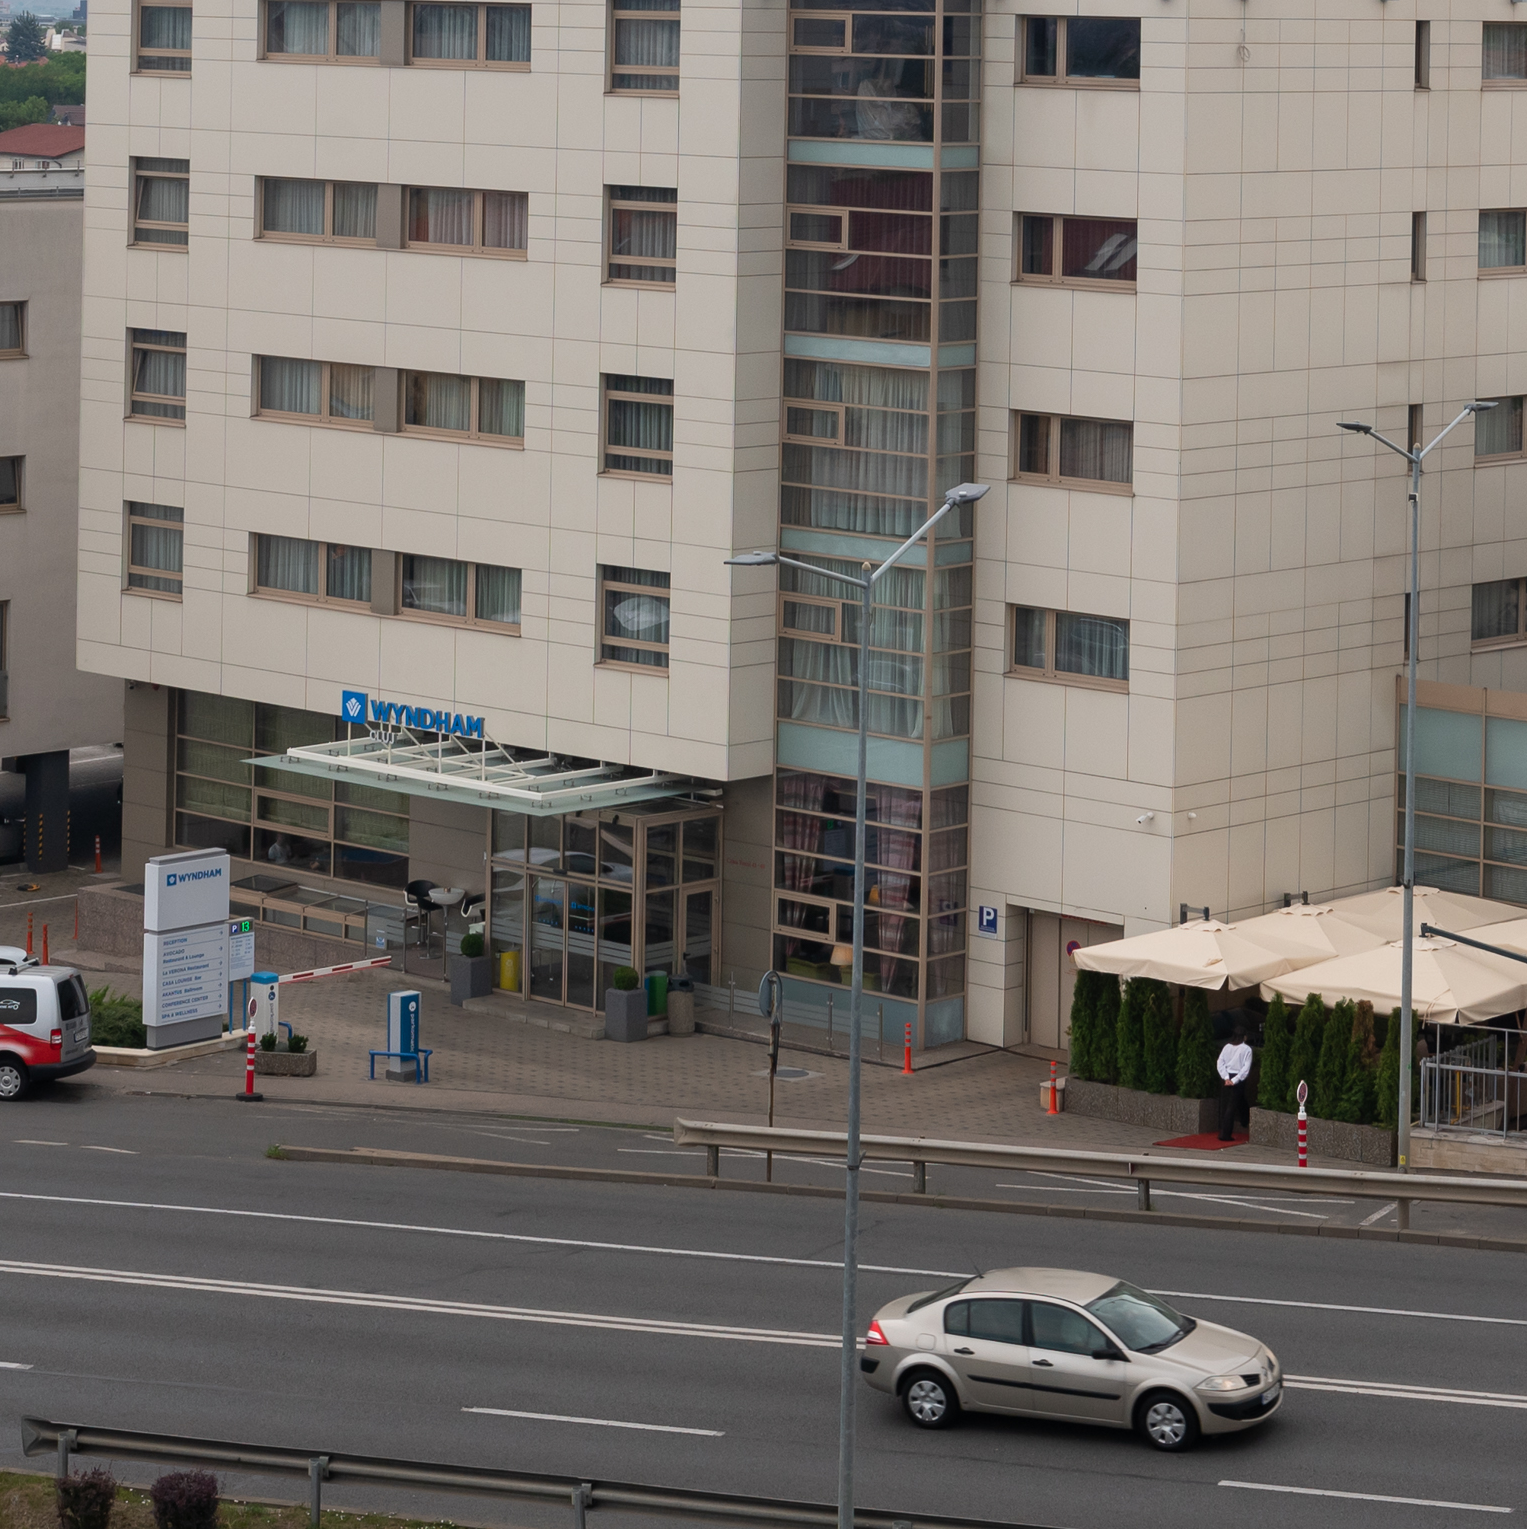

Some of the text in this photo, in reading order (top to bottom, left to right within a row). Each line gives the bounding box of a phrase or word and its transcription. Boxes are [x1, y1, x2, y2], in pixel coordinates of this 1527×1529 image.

[370, 699, 485, 739] WYNDHAM
[370, 729, 397, 745] CLUJ
[178, 868, 222, 883] WYNDHAM
[982, 907, 995, 926] P
[241, 921, 250, 932] 13
[164, 938, 187, 946] RECEPTION
